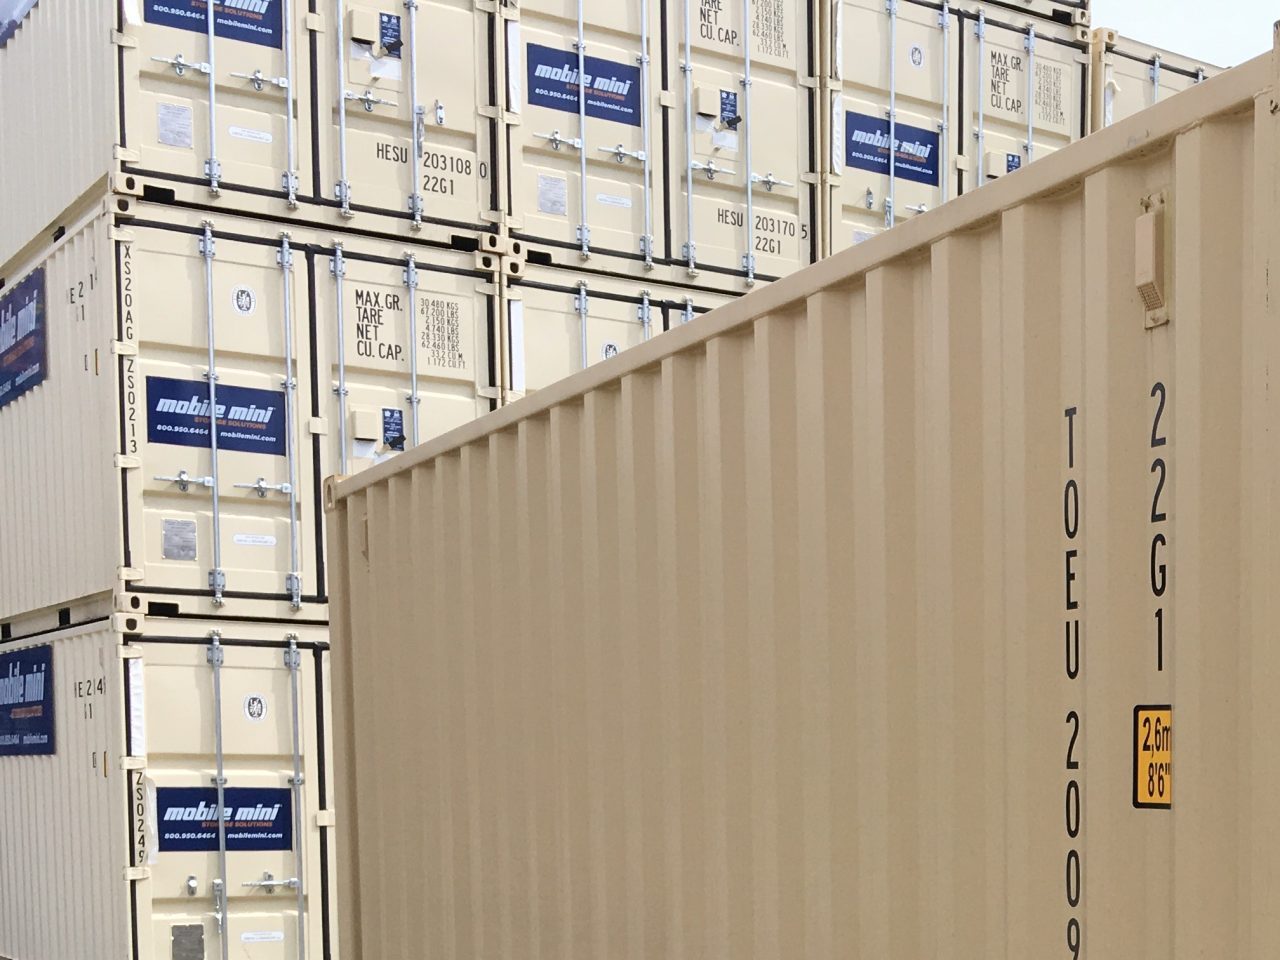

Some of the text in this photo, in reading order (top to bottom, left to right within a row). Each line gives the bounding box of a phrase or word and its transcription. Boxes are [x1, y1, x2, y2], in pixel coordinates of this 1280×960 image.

[217, 18, 273, 34] mobilemini.com
[700, 7, 719, 25] NET
[700, 24, 739, 46] CU. CAP.
[535, 64, 631, 95] mobie mini
[991, 65, 1010, 82] TARE
[991, 79, 1006, 95] NET
[991, 94, 1023, 114] CU. CAP.
[852, 130, 900, 150] mobie
[377, 142, 408, 163] HESU
[423, 152, 472, 175] 203108
[423, 175, 454, 195] 22G1
[718, 208, 807, 239] HESU 203170 5
[755, 236, 781, 255] 22G1
[124, 245, 133, 340] XS20AG
[356, 306, 384, 326] TARE
[446, 302, 459, 311] KGS
[446, 310, 459, 320] LBS
[356, 323, 379, 341] NET
[357, 340, 405, 362] CU. CAP.
[127, 358, 137, 453] ZS0213
[228, 405, 273, 423] mini
[156, 424, 209, 435] 800.950.6464
[228, 418, 266, 430] SOLUTIONS
[220, 431, 276, 443] mobilemini.com
[1150, 381, 1167, 672] 22G1
[1064, 406, 1080, 680] TOEU
[1142, 716, 1171, 758] 2,6m
[136, 772, 145, 863] ZS0249
[235, 804, 280, 821] mini
